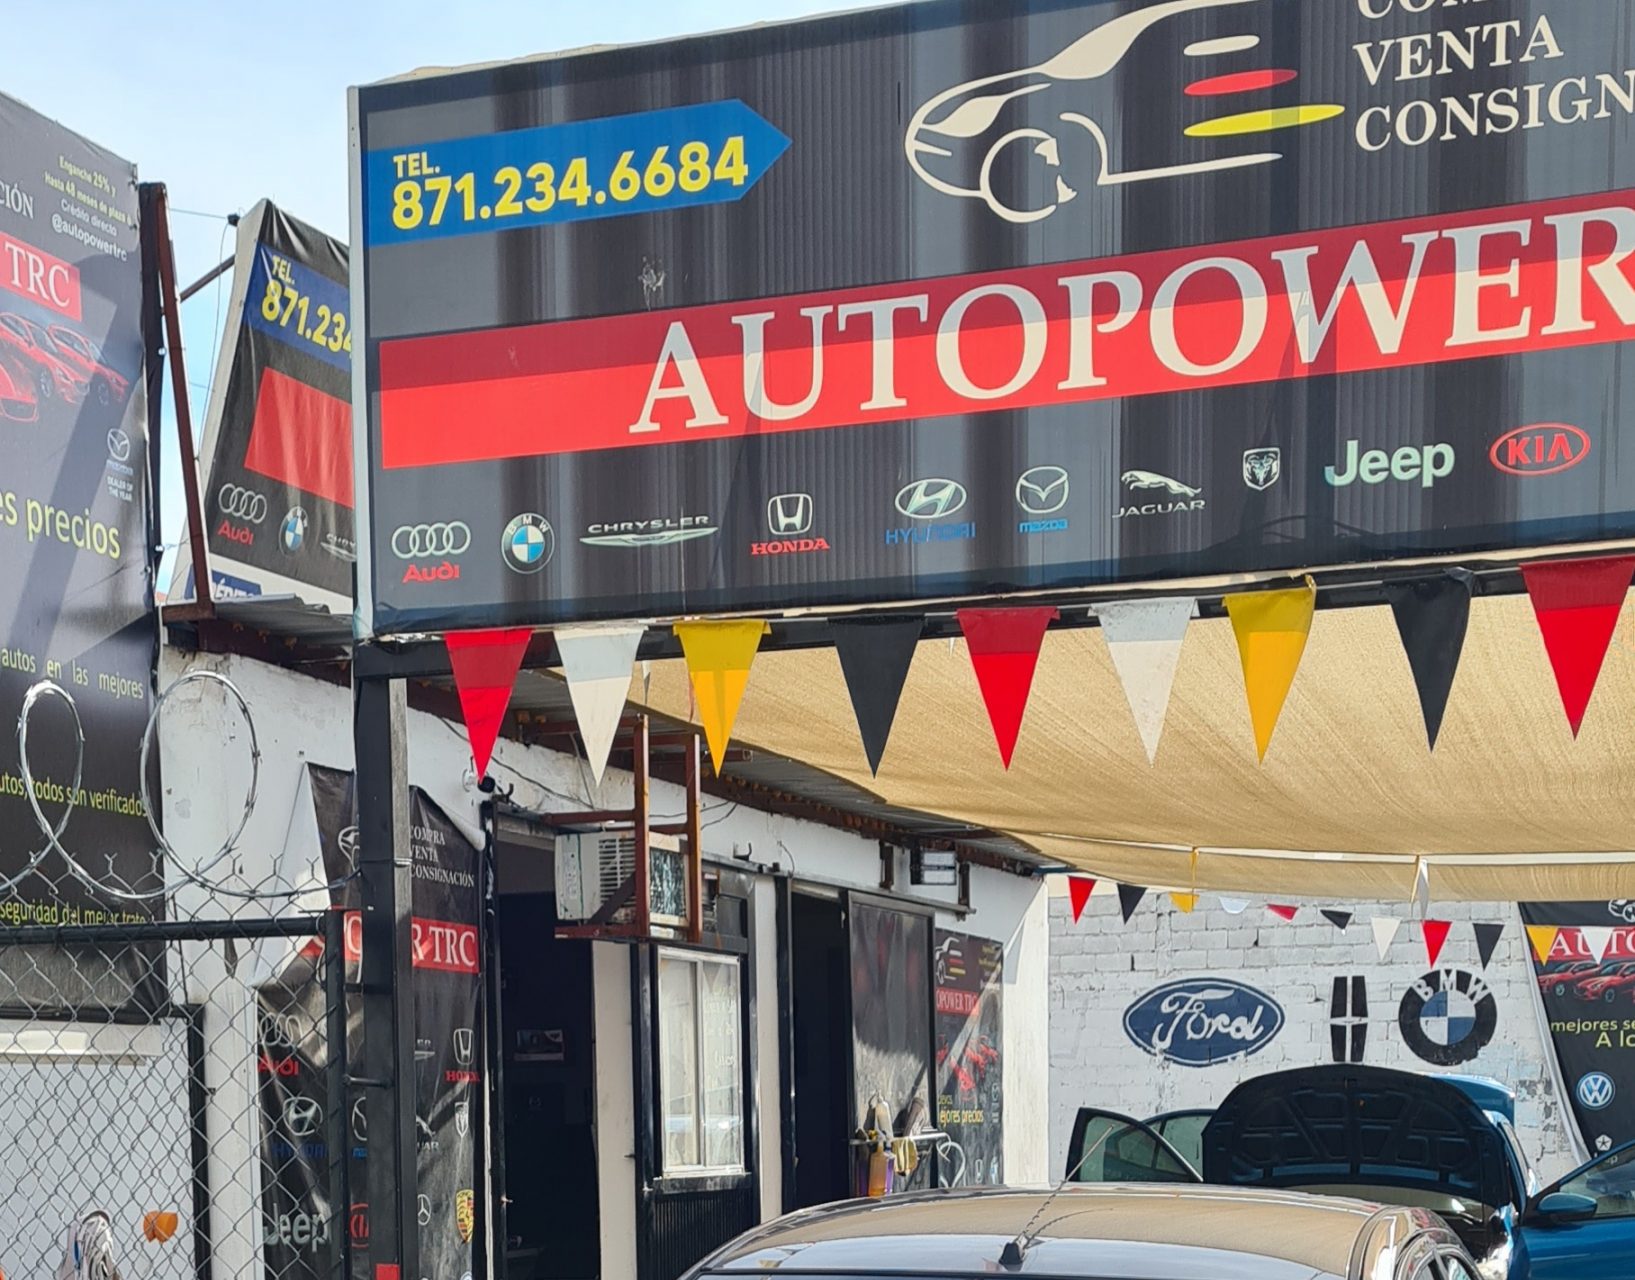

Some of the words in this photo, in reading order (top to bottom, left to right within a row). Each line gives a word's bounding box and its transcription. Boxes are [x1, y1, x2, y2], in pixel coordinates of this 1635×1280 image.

[1353, 15, 1564, 86] VENTA
[1355, 70, 1635, 151] CONSIGN
[393, 151, 440, 177] TEL.
[392, 136, 749, 230] 871.234.6684
[51, 213, 127, 262] @autopowertrc
[5, 241, 70, 308] TRC
[272, 255, 295, 285] TEL.
[628, 205, 1635, 435] AUTOPOWER
[1325, 439, 1456, 488] Jeep
[1507, 433, 1574, 466] KIA
[588, 515, 711, 534] CHRYSLER
[1111, 499, 1206, 518] JAGUAR
[27, 498, 121, 559] precios
[218, 519, 254, 545] Audi
[751, 536, 831, 556] HONDA
[885, 521, 976, 545] HYUNDAI
[402, 562, 461, 584] Audi
[1, 648, 36, 673] autos
[47, 660, 62, 679] en
[72, 660, 89, 686] las
[99, 671, 144, 699] mejores
[429, 925, 475, 967] TRC
[1151, 988, 1265, 1050] Ford
[1551, 1018, 1618, 1034] mejores
[1595, 1031, 1612, 1048] A
